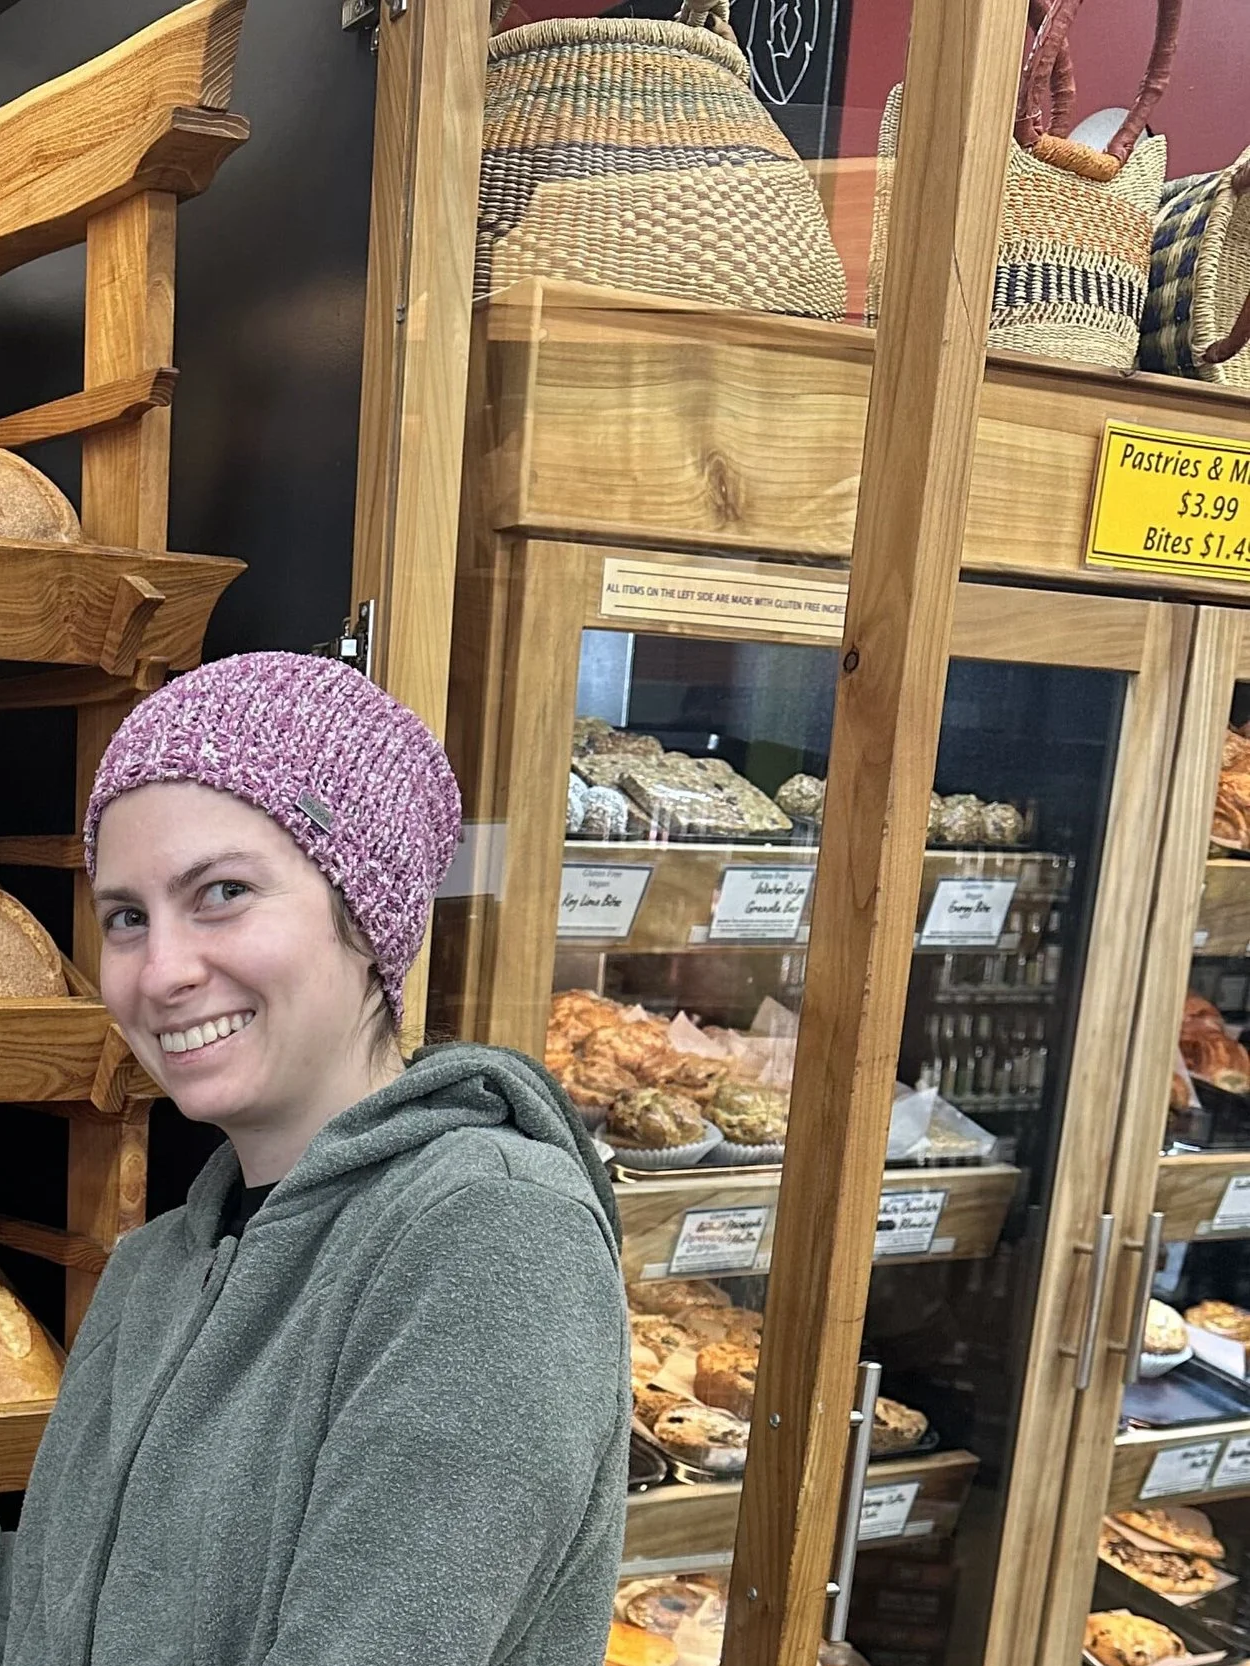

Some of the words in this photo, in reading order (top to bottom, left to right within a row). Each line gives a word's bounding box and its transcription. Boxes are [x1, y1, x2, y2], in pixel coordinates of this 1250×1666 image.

[1120, 443, 1201, 478] Pastries
[1207, 456, 1223, 480] &
[1229, 458, 1250, 485] M
[1177, 490, 1239, 521] $3.99
[1143, 526, 1193, 555] Bites
[606, 583, 620, 593] ALL
[622, 584, 645, 595] ITEMS
[646, 586, 659, 596] ON
[661, 588, 676, 598] THE
[677, 590, 695, 600] LEFT
[696, 591, 714, 601] SIDE
[716, 593, 730, 604] ARE
[731, 595, 753, 605] MADE
[754, 597, 773, 607] WITH
[774, 599, 802, 610] GLUTEN
[803, 602, 820, 613] FREE
